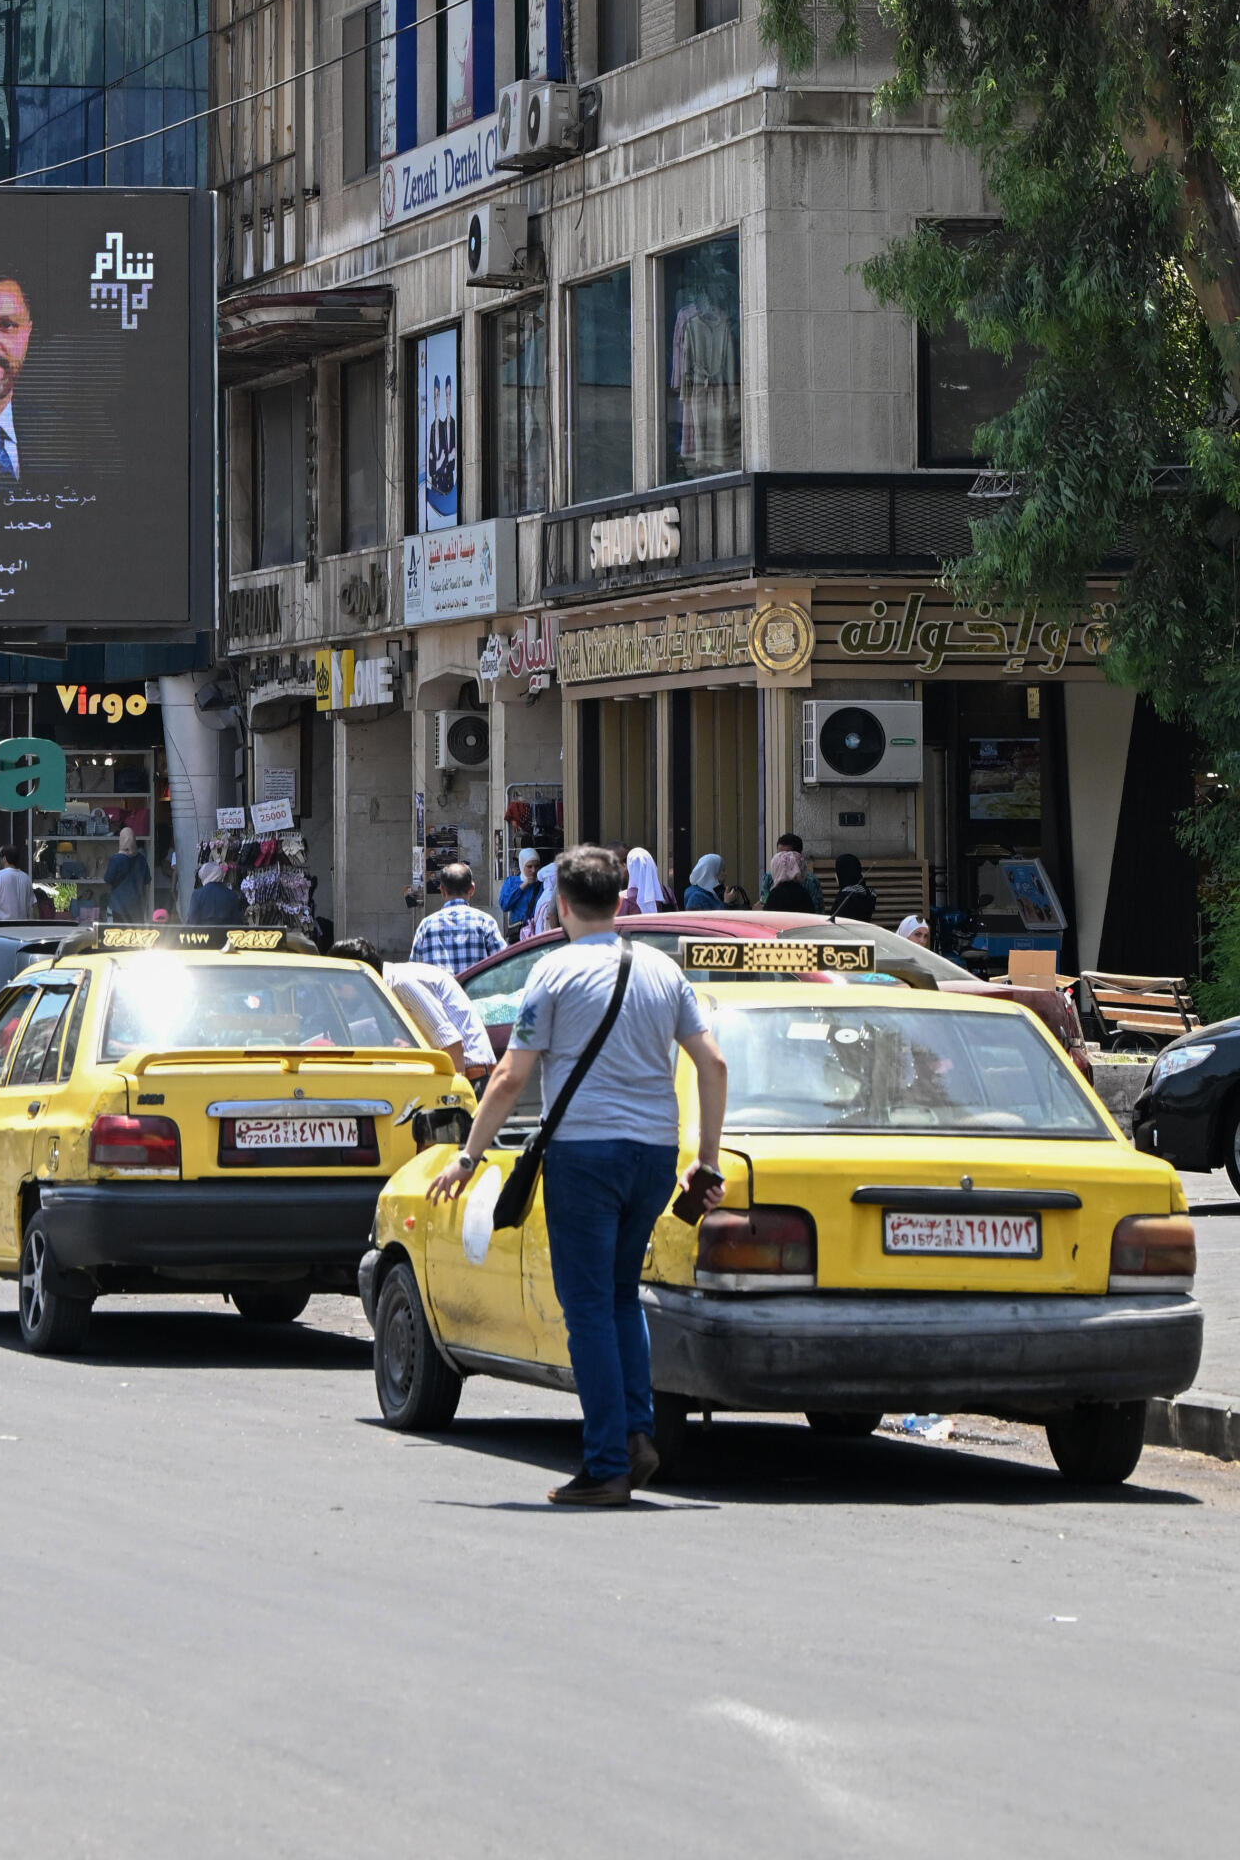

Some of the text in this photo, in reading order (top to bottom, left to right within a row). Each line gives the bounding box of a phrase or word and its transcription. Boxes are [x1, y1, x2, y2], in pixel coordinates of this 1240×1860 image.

[403, 155, 438, 211] Zenati
[444, 132, 482, 194] Dental
[3, 488, 49, 506] دمشق
[4, 519, 52, 531] محمد
[591, 507, 680, 569] SHADOWS
[839, 592, 1072, 674] وإخوانه
[56, 685, 147, 724] Virgo
[260, 810, 287, 823] 25000
[103, 928, 160, 948] TAXI
[226, 930, 283, 949] TAXI
[692, 944, 738, 967] TAXI
[822, 946, 869, 969] أجرة
[239, 1121, 280, 1134] دمشق
[300, 1121, 355, 1143] ٤٧٢٦١٨
[965, 1219, 1034, 1247] ٦٩١٥٧٢
